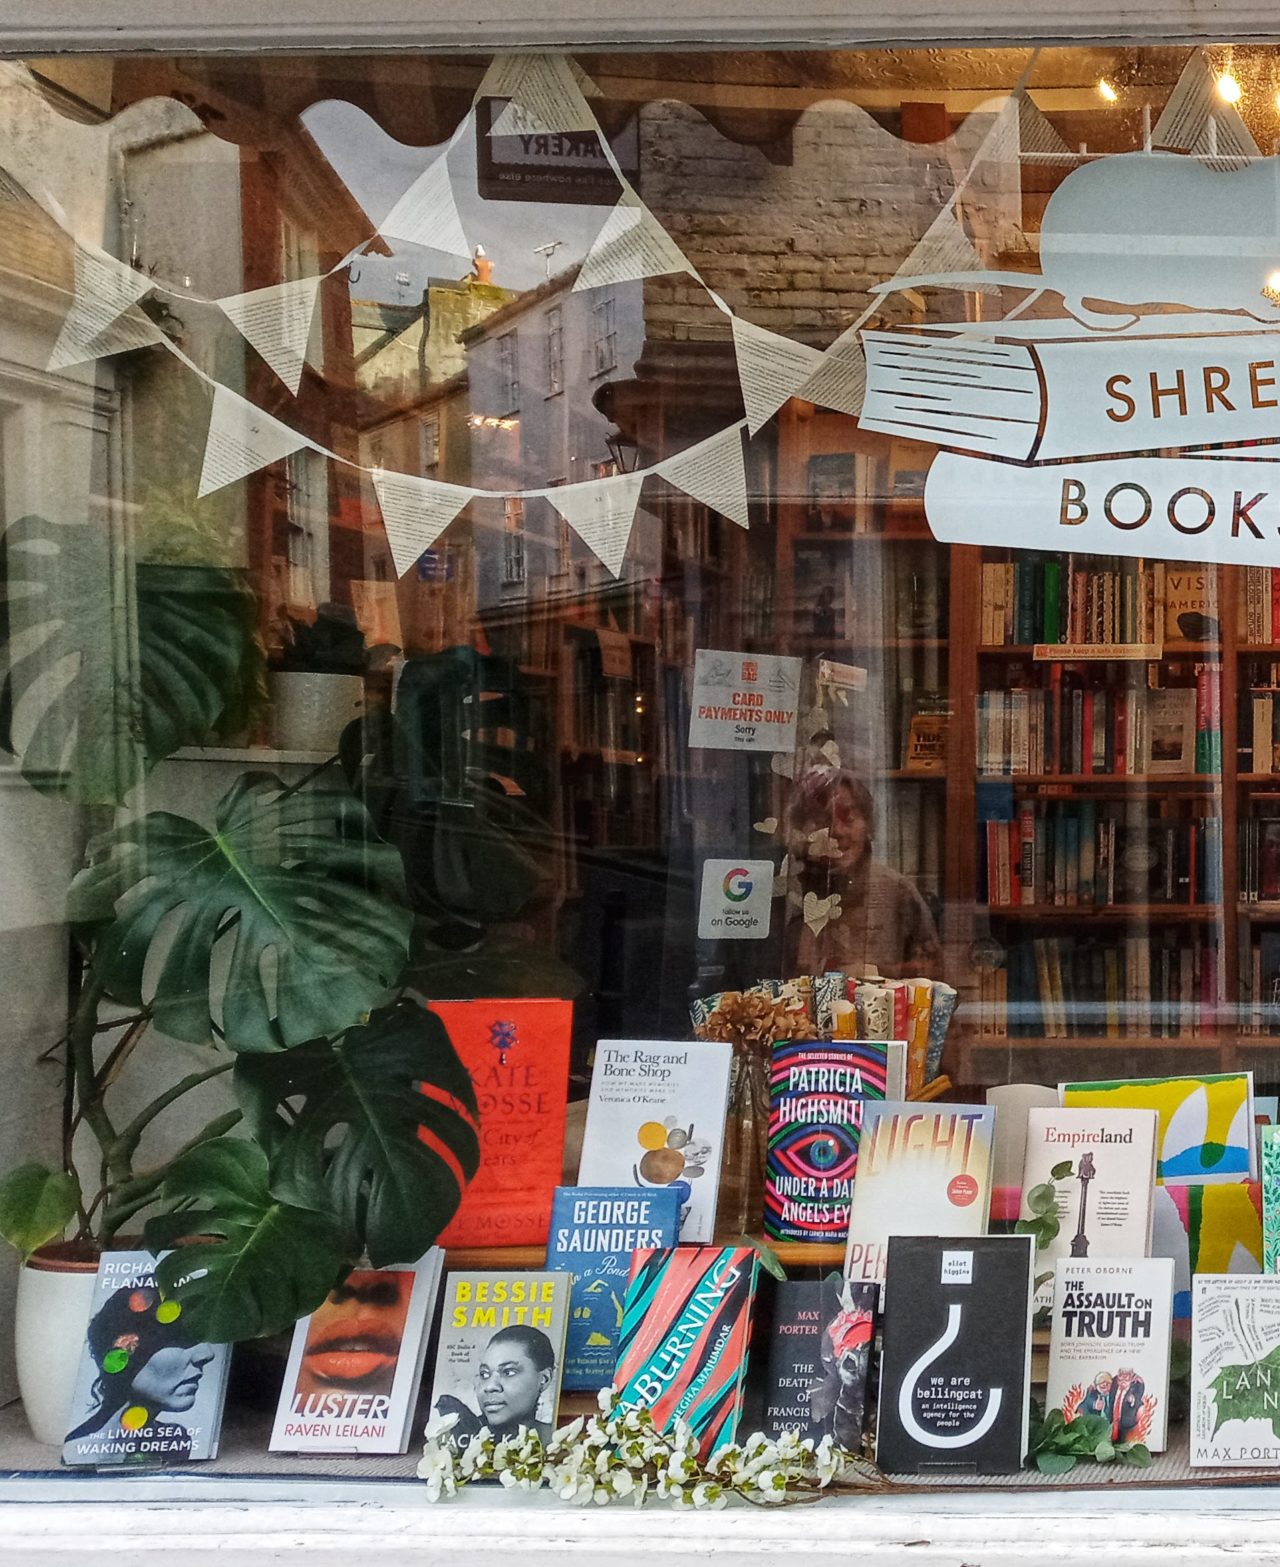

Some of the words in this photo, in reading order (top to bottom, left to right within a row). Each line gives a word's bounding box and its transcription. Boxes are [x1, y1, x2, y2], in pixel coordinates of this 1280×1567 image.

[732, 692, 764, 707] CARD
[698, 706, 763, 723] PAYMENTS
[764, 710, 793, 724] ONLY
[725, 916, 759, 929] Google
[603, 1050, 630, 1063] The
[634, 1050, 661, 1067] Rag
[663, 1052, 689, 1065] and
[603, 1064, 636, 1077] Bone
[638, 1064, 672, 1081] Shop
[788, 1066, 863, 1094] PATRICIA
[483, 1128, 522, 1146] City
[1044, 1127, 1133, 1148] Empireland
[776, 1176, 818, 1196] UNDER
[573, 1201, 651, 1224] GEORGE
[780, 1202, 830, 1223] ANGEL'S
[556, 1228, 663, 1252] SAUNDERS
[104, 1262, 155, 1275] RICHA
[456, 1281, 555, 1303] BESSIE
[1064, 1281, 1084, 1291] THE
[1062, 1292, 1135, 1309] ASSAULT
[1134, 1298, 1153, 1309] ON
[452, 1307, 553, 1329] SMITH
[797, 1311, 820, 1321] MAX
[778, 1325, 819, 1335] PORTER
[1061, 1310, 1152, 1338] TRUTH
[792, 1363, 815, 1374] THE
[778, 1377, 813, 1388] DEATH
[930, 1377, 947, 1386] we
[950, 1377, 971, 1385] are
[916, 1387, 983, 1400] bellingcat
[291, 1393, 391, 1419] LUSTER
[767, 1407, 811, 1417] FRANCIS
[932, 1402, 977, 1411] intelligence
[108, 1428, 153, 1440] LIVING
[157, 1427, 183, 1437] SEA
[186, 1427, 203, 1437] OF
[284, 1424, 332, 1438] RAVEN
[336, 1424, 385, 1438] LEILANI
[772, 1421, 809, 1431] BACON
[76, 1442, 136, 1455] WAKING
[140, 1440, 200, 1453] DREAMS
[1196, 1447, 1231, 1460] MAX
